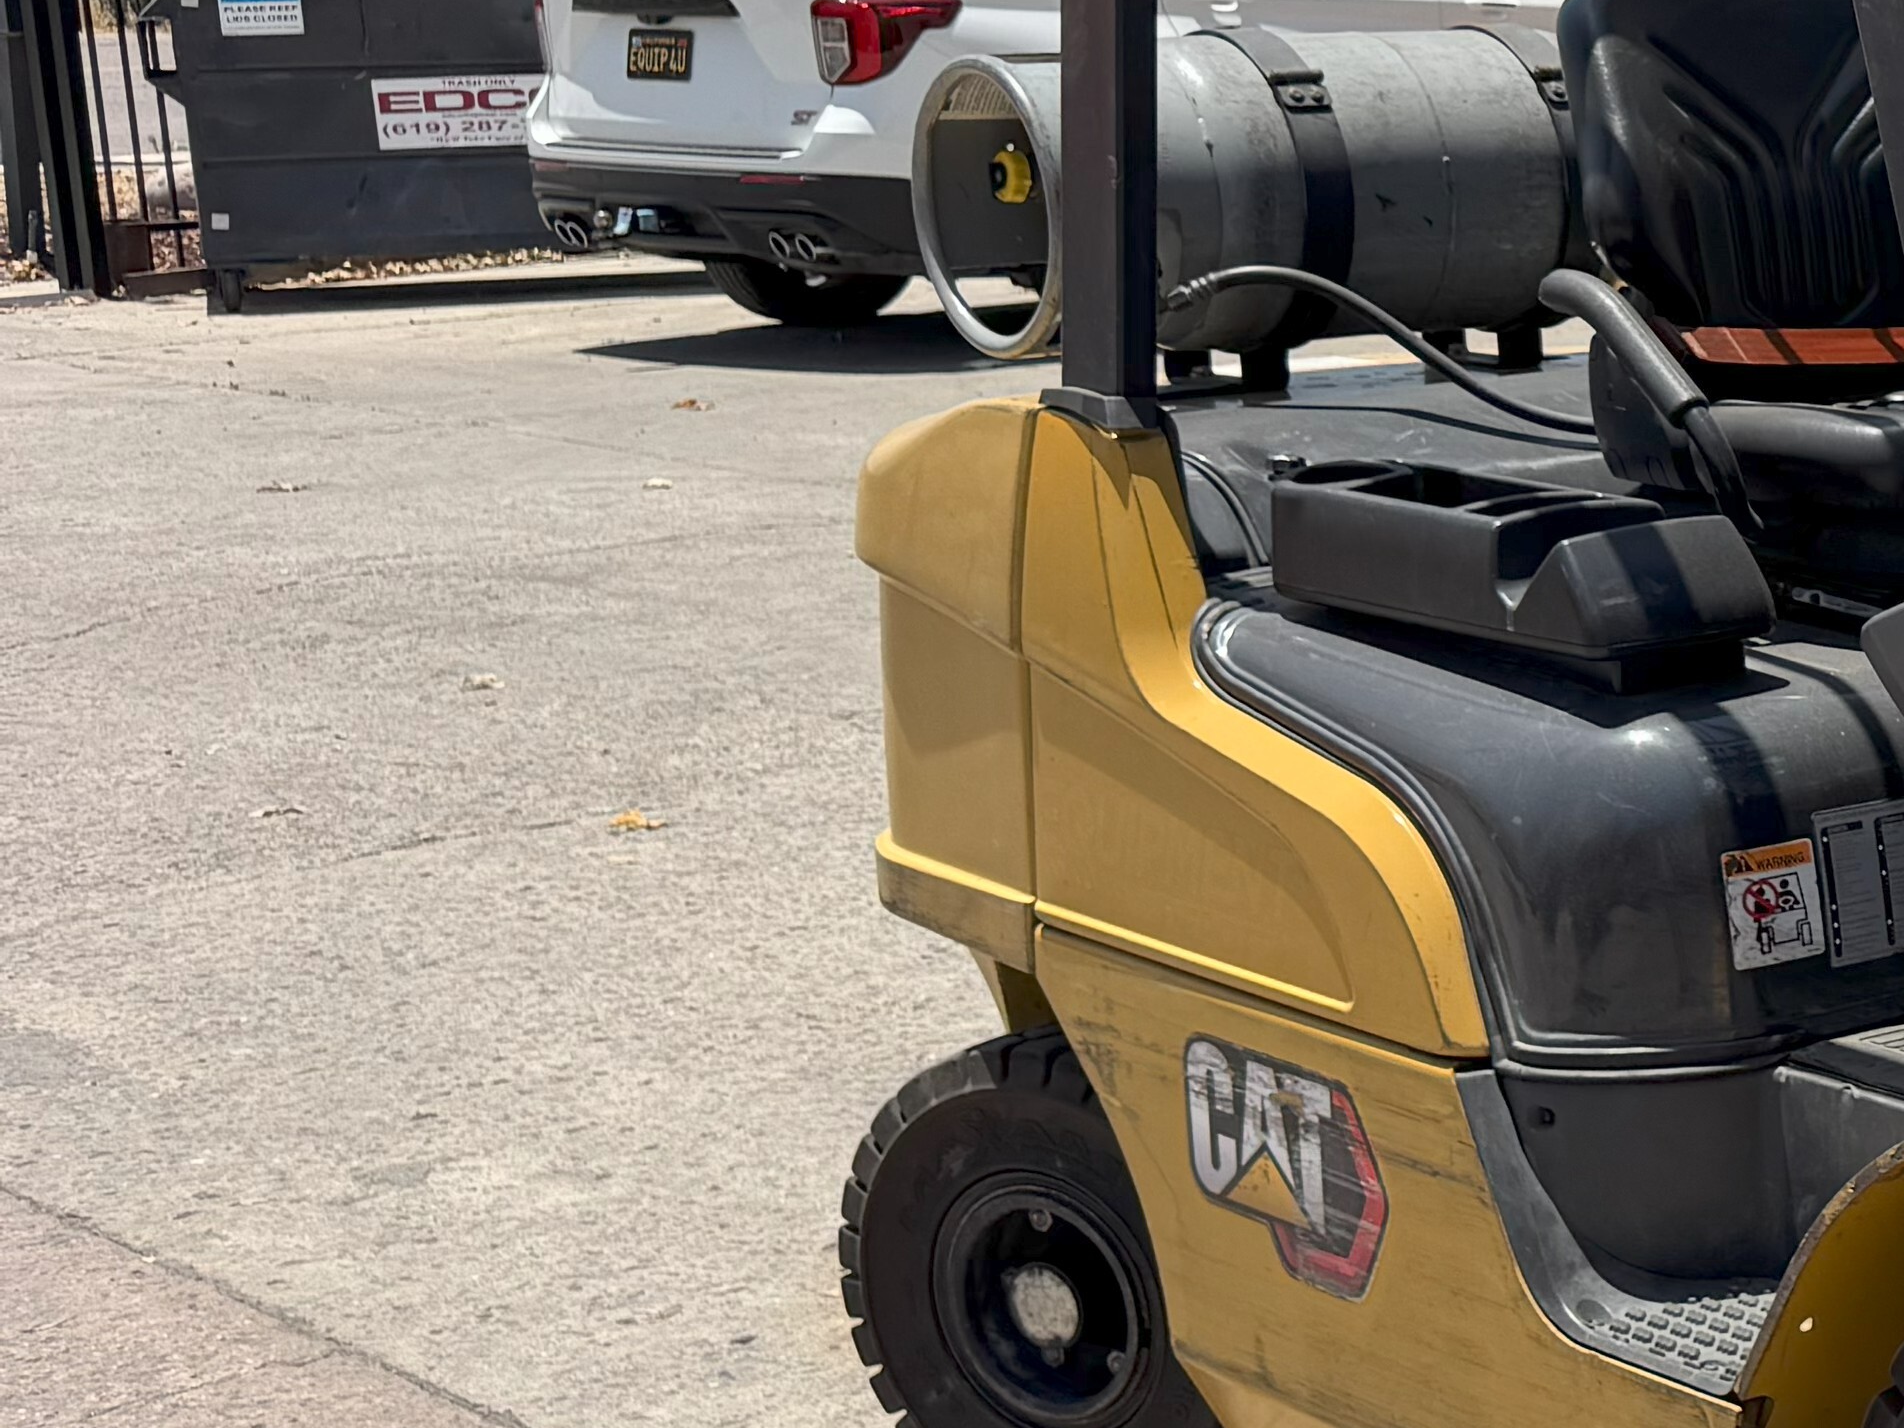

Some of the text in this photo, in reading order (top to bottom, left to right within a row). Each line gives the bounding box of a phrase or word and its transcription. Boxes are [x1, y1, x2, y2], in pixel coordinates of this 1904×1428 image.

[223, 4, 298, 13] PLEASE KEEP
[441, 79, 482, 88] TRASH
[382, 121, 451, 139] (619)
[460, 118, 527, 133] 287-
[1757, 851, 1806, 871] WARNING
[1185, 1040, 1333, 1239] CAT
